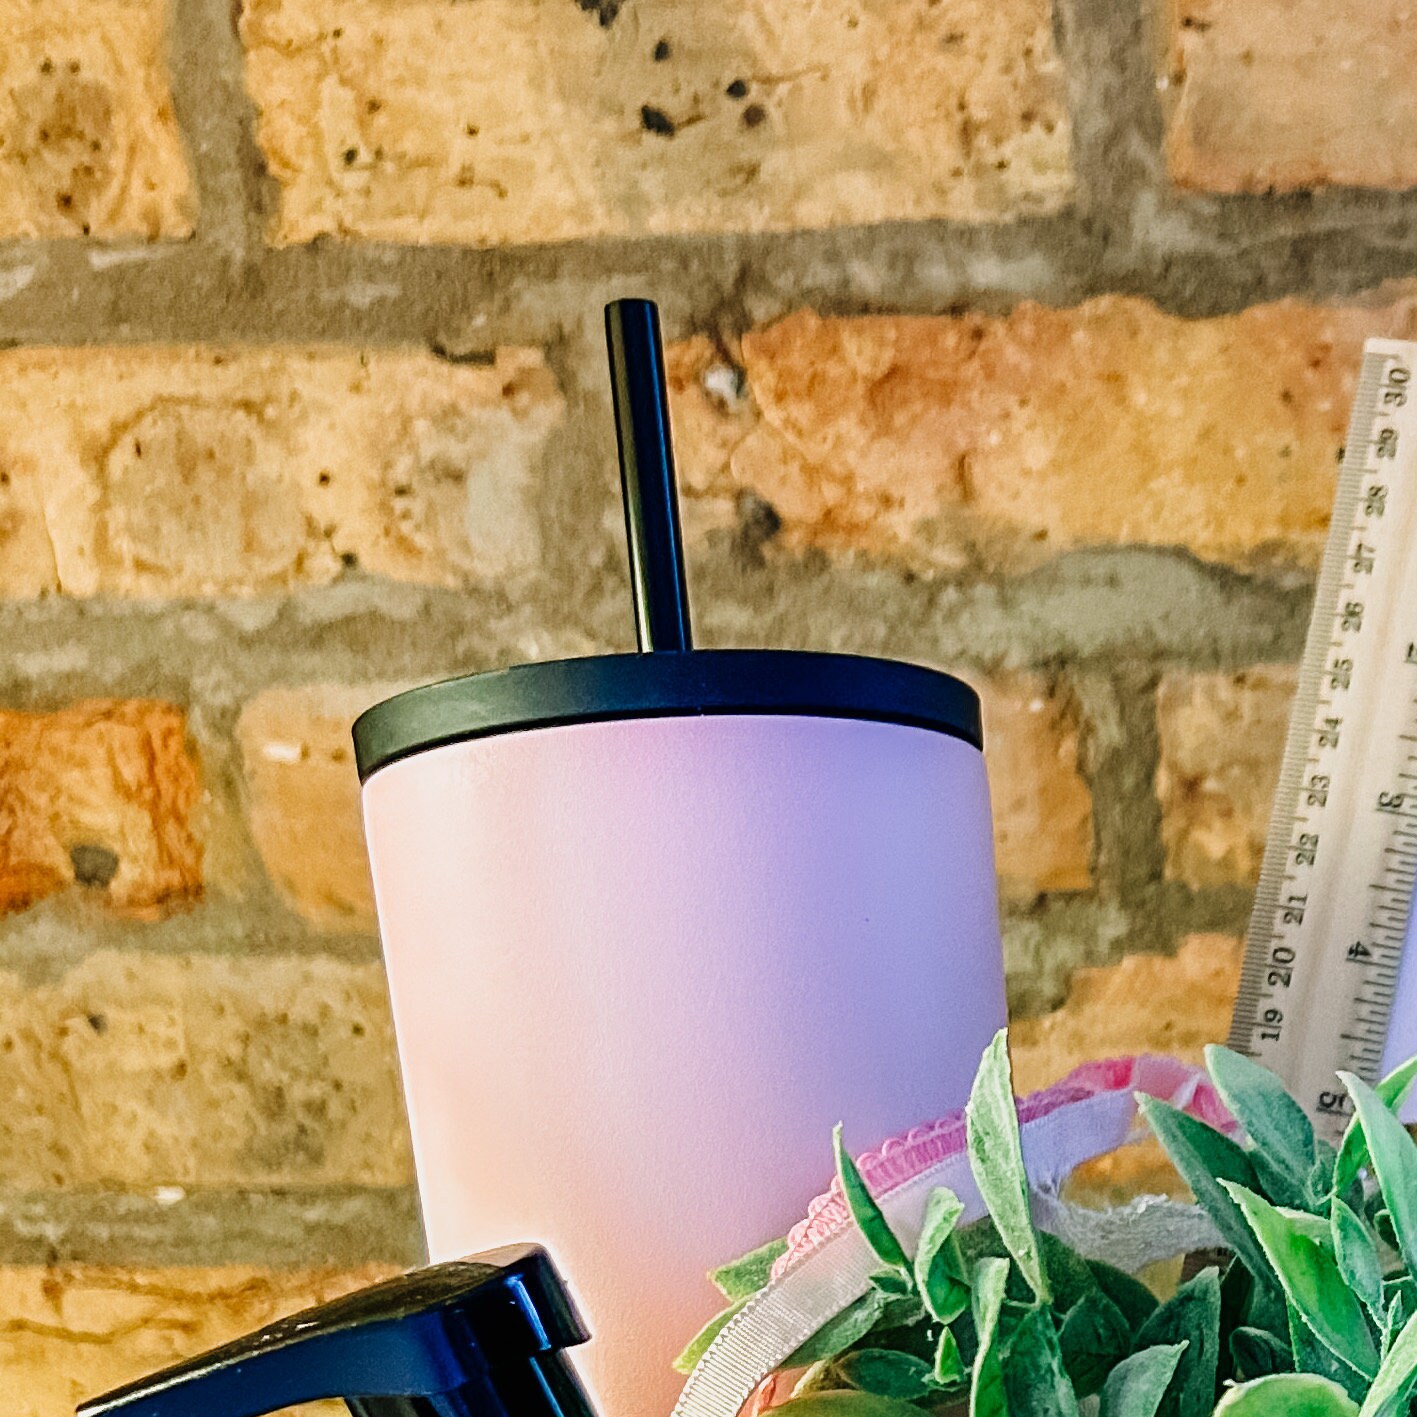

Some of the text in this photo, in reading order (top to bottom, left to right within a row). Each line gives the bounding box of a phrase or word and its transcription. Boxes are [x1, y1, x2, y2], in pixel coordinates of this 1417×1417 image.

[1260, 366, 1411, 1042] 19 20 21 22 23 24 25 26 27 28 29 30
[1377, 789, 1405, 810] 3
[1348, 938, 1373, 960] 4
[1318, 1090, 1347, 1110] 5
